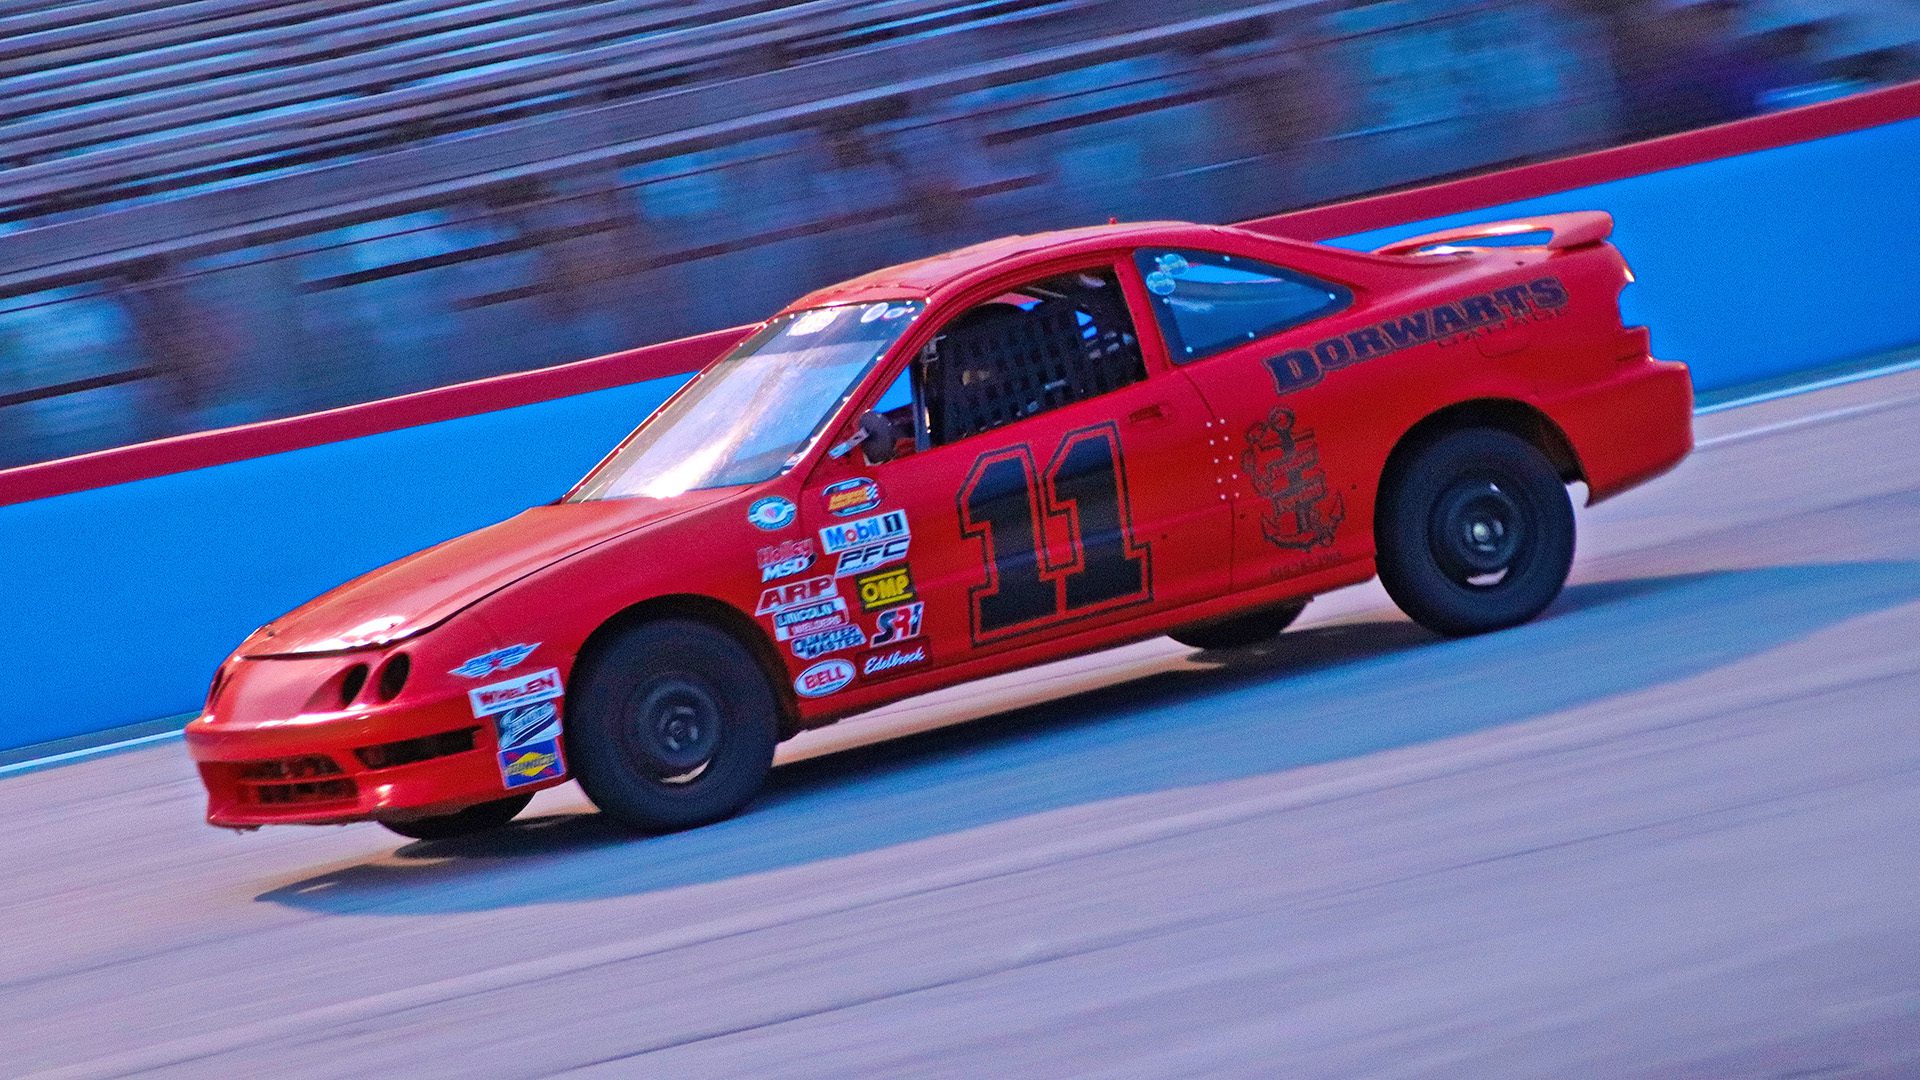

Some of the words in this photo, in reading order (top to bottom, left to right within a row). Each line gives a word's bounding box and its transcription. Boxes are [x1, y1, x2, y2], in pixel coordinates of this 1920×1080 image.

[1260, 276, 1569, 396] DORWARTS
[826, 517, 880, 547] Mobil
[885, 515, 901, 533] 1
[955, 419, 1154, 648] 11
[840, 538, 909, 569] PFC
[762, 556, 810, 583] MSD
[762, 576, 833, 611] ARP
[862, 575, 909, 601] OMP
[778, 603, 833, 627] LINCOLN
[864, 646, 925, 675] Edelbrock
[804, 666, 845, 689] BELL
